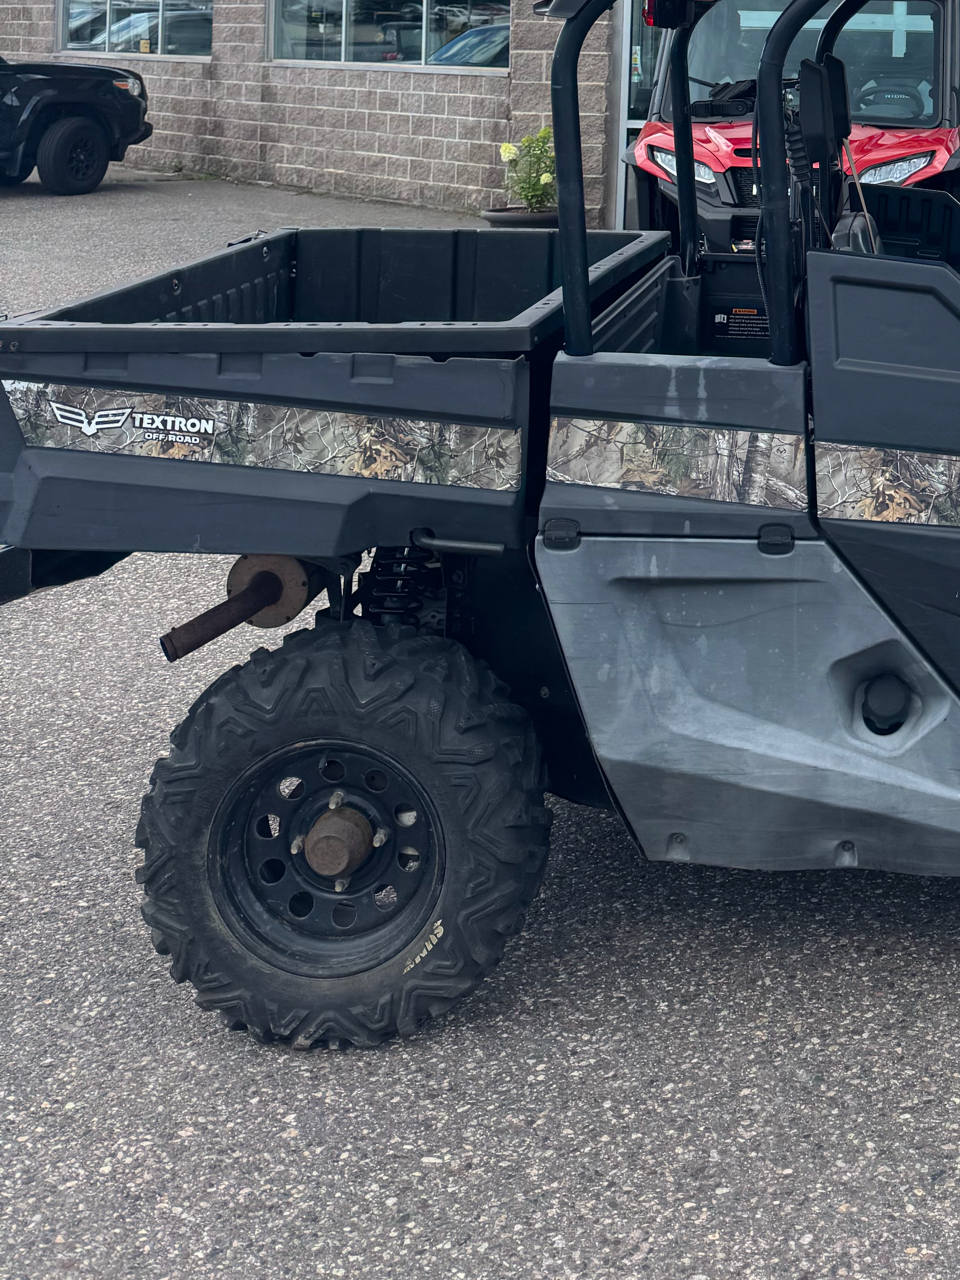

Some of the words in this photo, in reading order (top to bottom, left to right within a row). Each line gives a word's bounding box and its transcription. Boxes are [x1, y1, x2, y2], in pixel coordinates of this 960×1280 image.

[132, 413, 214, 434] TEXTRON
[144, 432, 166, 440] OFF
[168, 433, 200, 444] ROAD
